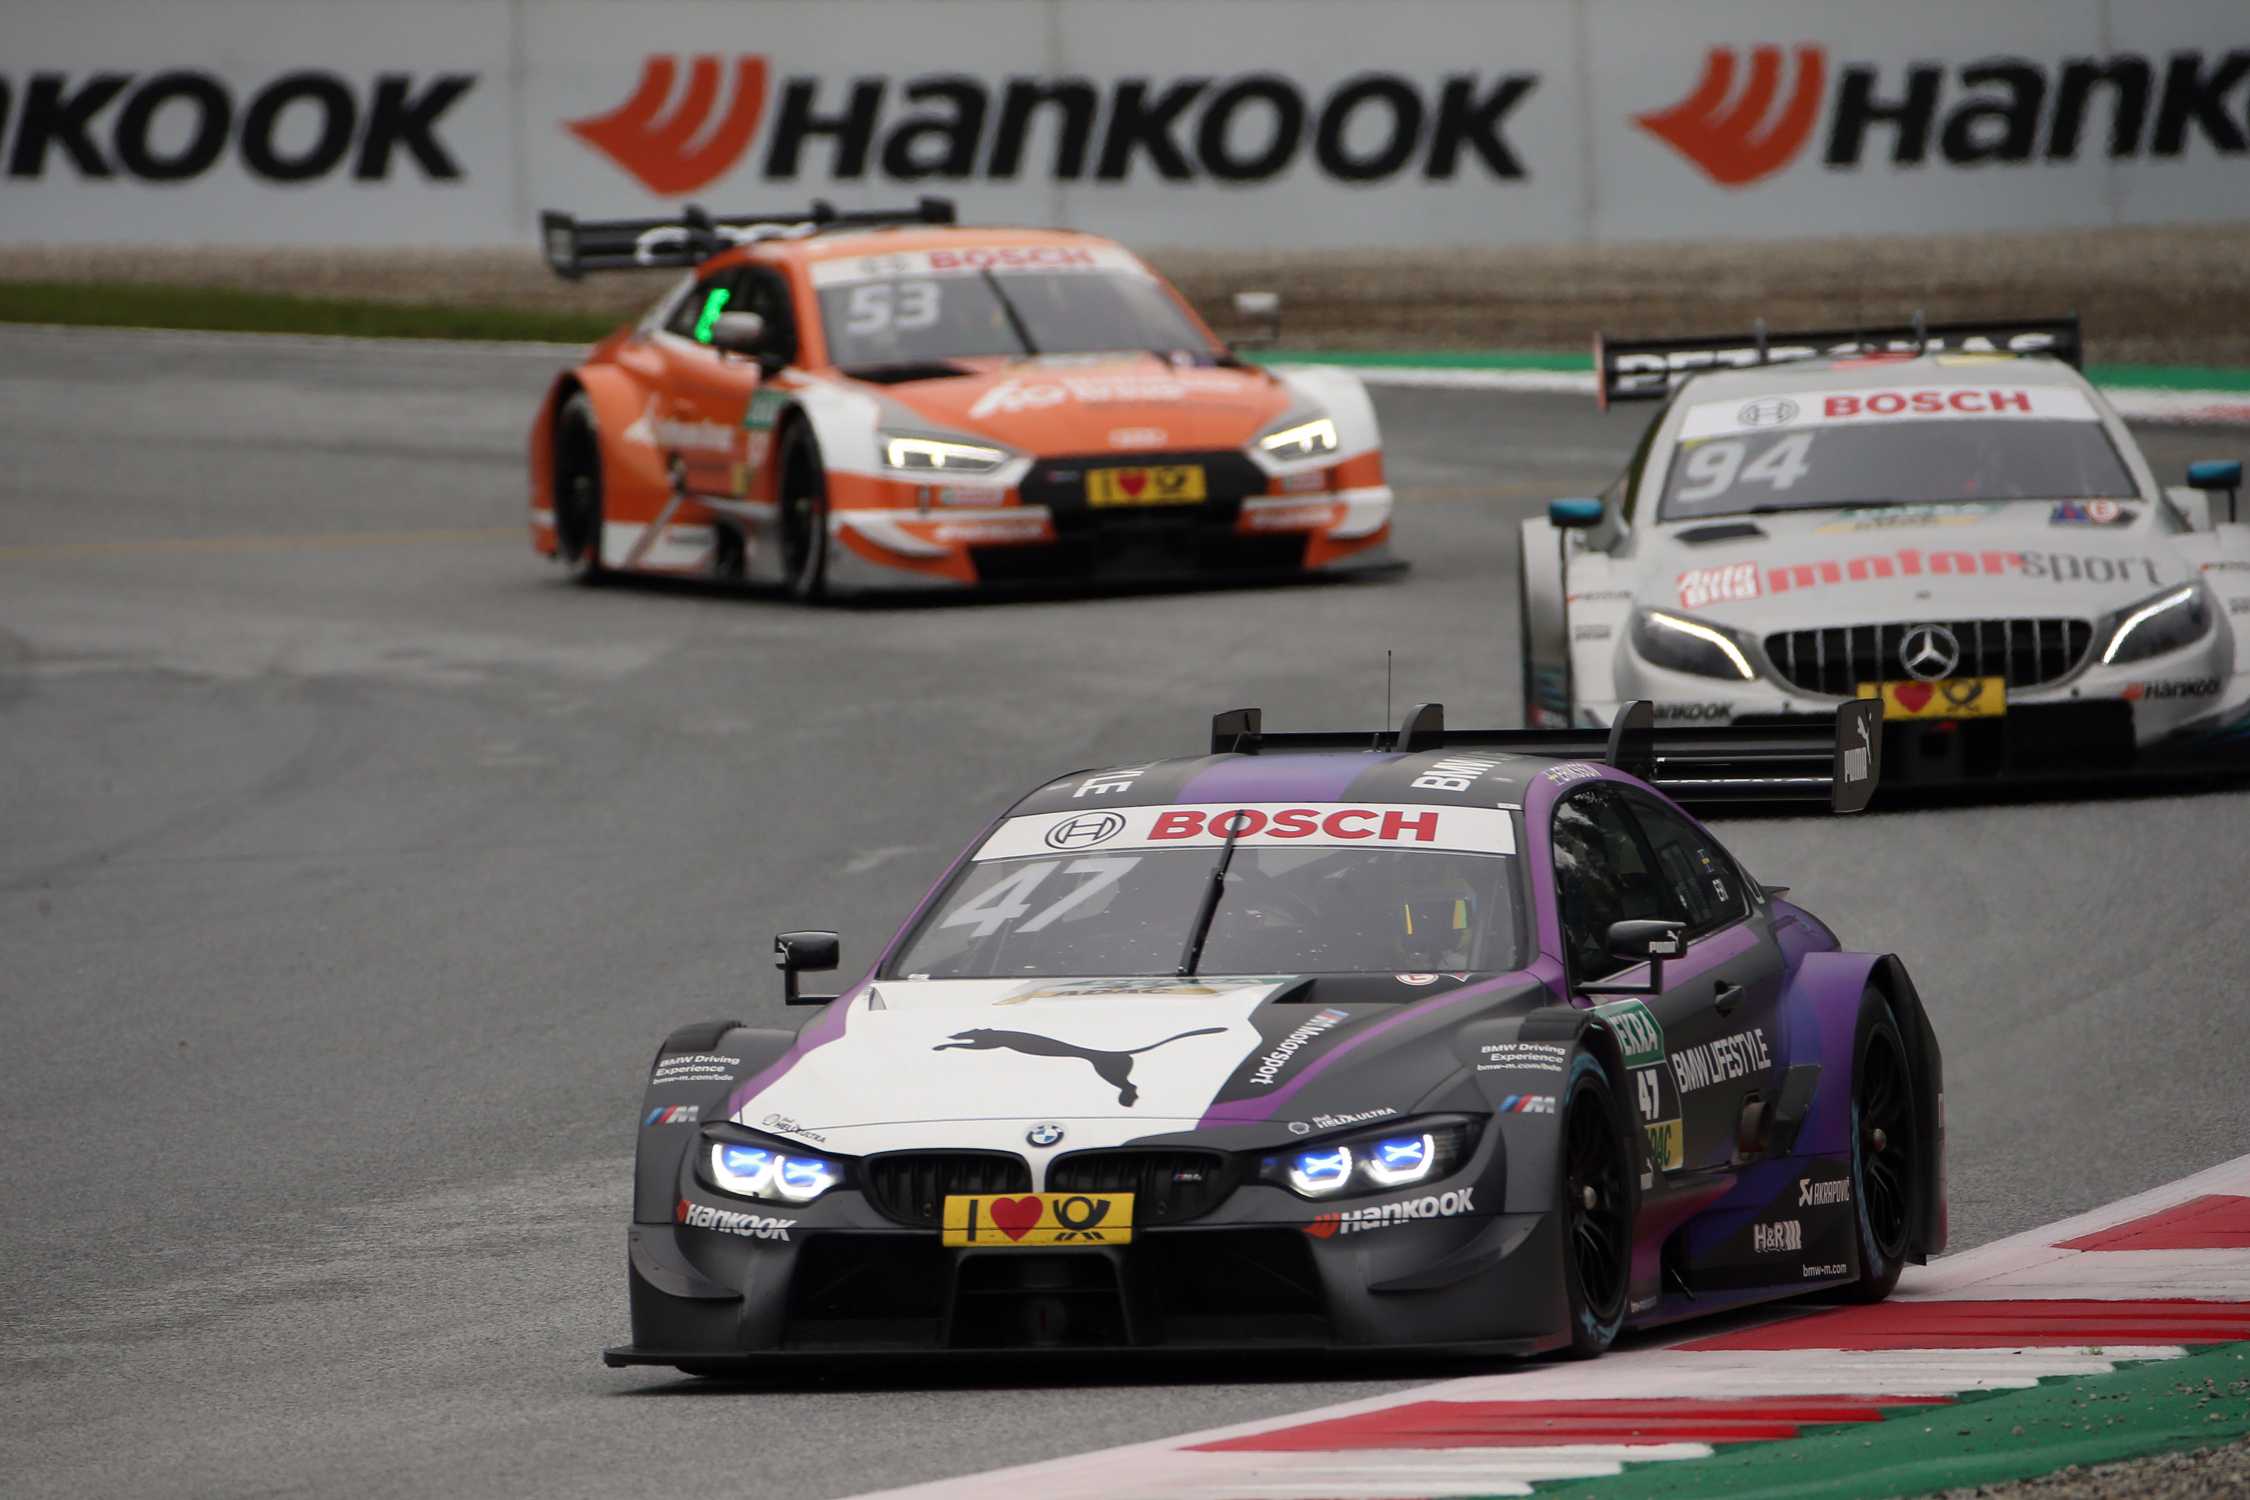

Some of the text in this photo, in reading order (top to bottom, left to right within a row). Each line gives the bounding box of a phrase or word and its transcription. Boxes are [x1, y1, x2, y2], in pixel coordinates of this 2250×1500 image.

[929, 248, 1097, 269] BOSCH
[847, 280, 942, 334] 53
[1823, 390, 2032, 418] BOSCH
[1681, 433, 1815, 502] 94
[1147, 808, 1439, 842] BOSCH
[940, 856, 1143, 938] 47
[659, 1055, 740, 1068] BMW Driving
[1481, 1043, 1567, 1055] BMW Driving
[1490, 1053, 1565, 1064] Experience
[1671, 1028, 1772, 1093] BMW LIFESTYLE
[656, 1065, 726, 1077] Experience
[1637, 1069, 1661, 1121] 47
[1356, 1106, 1398, 1121] ULTRA
[1753, 1220, 1786, 1252] H&R
[1802, 1263, 1847, 1277] bmw-m.com
